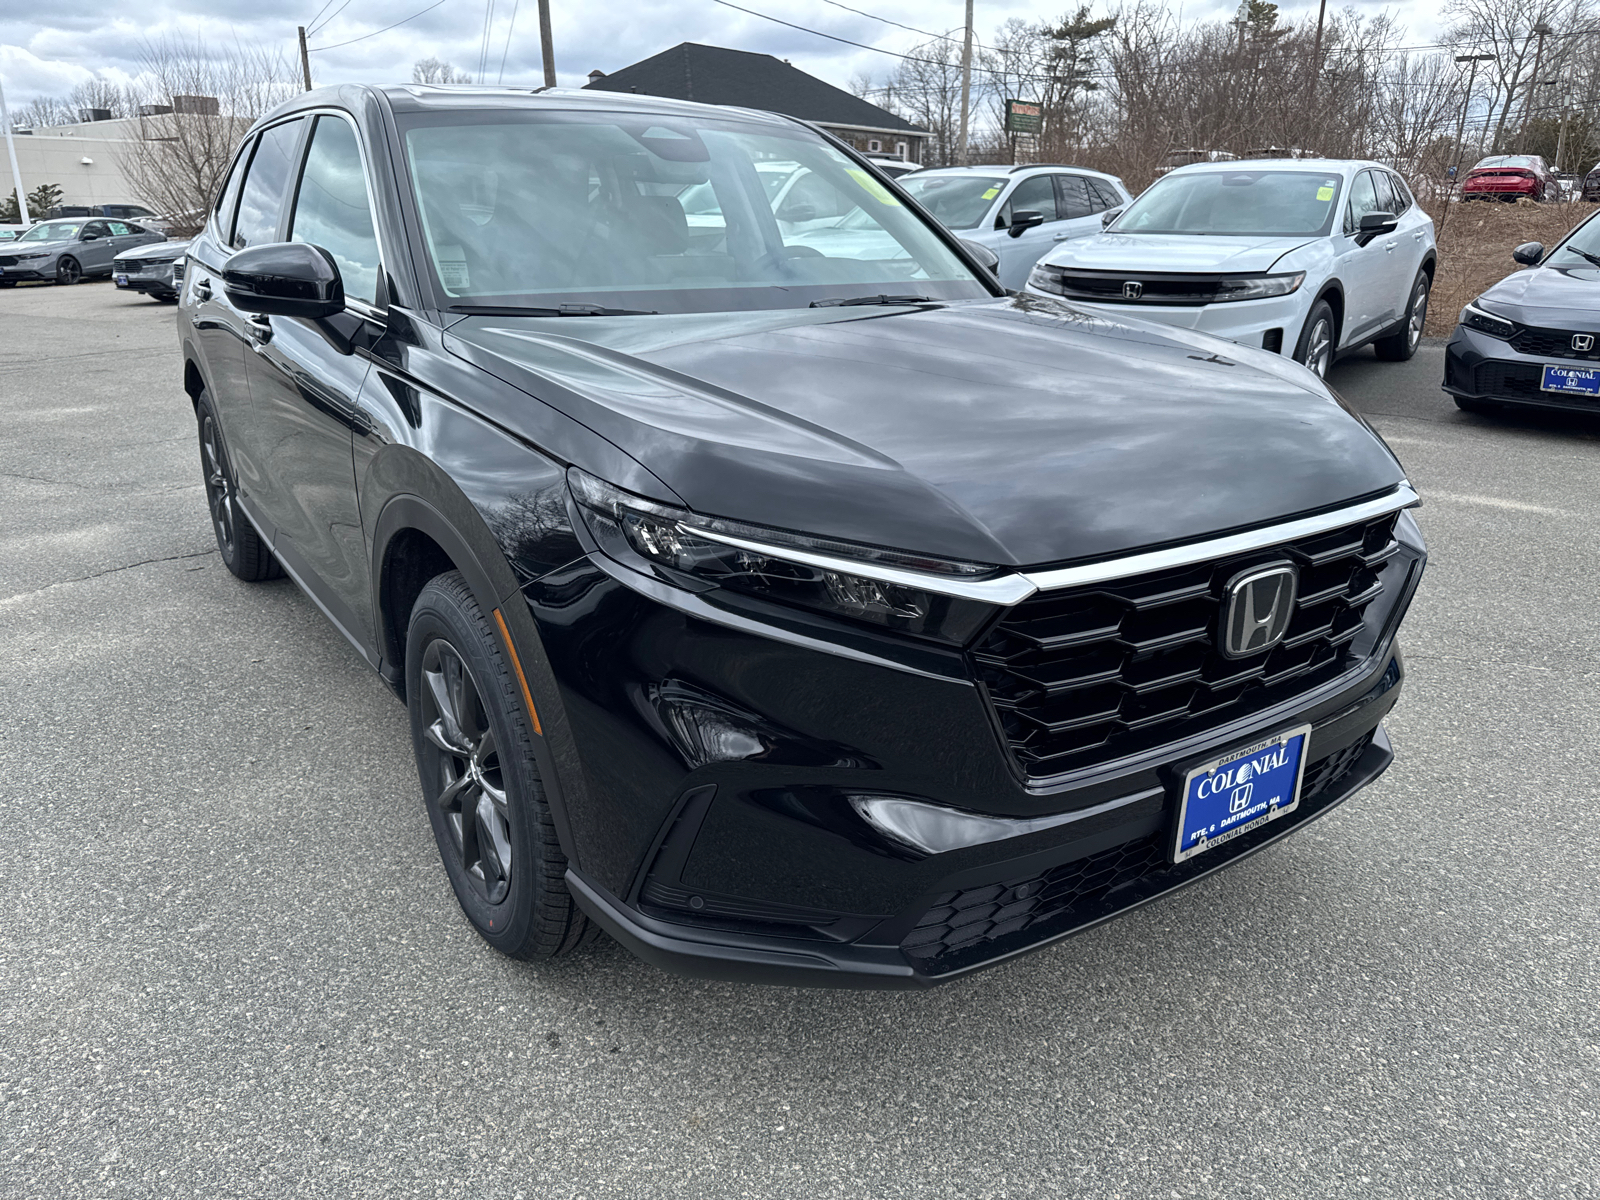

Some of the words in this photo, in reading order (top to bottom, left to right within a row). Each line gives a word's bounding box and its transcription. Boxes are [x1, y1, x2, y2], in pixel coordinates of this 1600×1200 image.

[1551, 369, 1595, 380] COLONIAL
[1270, 735, 1282, 745] MA
[1197, 747, 1290, 799] COLONIAL
[1190, 827, 1208, 841] RTE.
[1210, 824, 1215, 832] 6
[1220, 801, 1268, 828] DARTMOUTH,
[1269, 795, 1281, 805] MA
[1206, 828, 1243, 849] COLONIAL
[1244, 815, 1270, 833] HONDA
